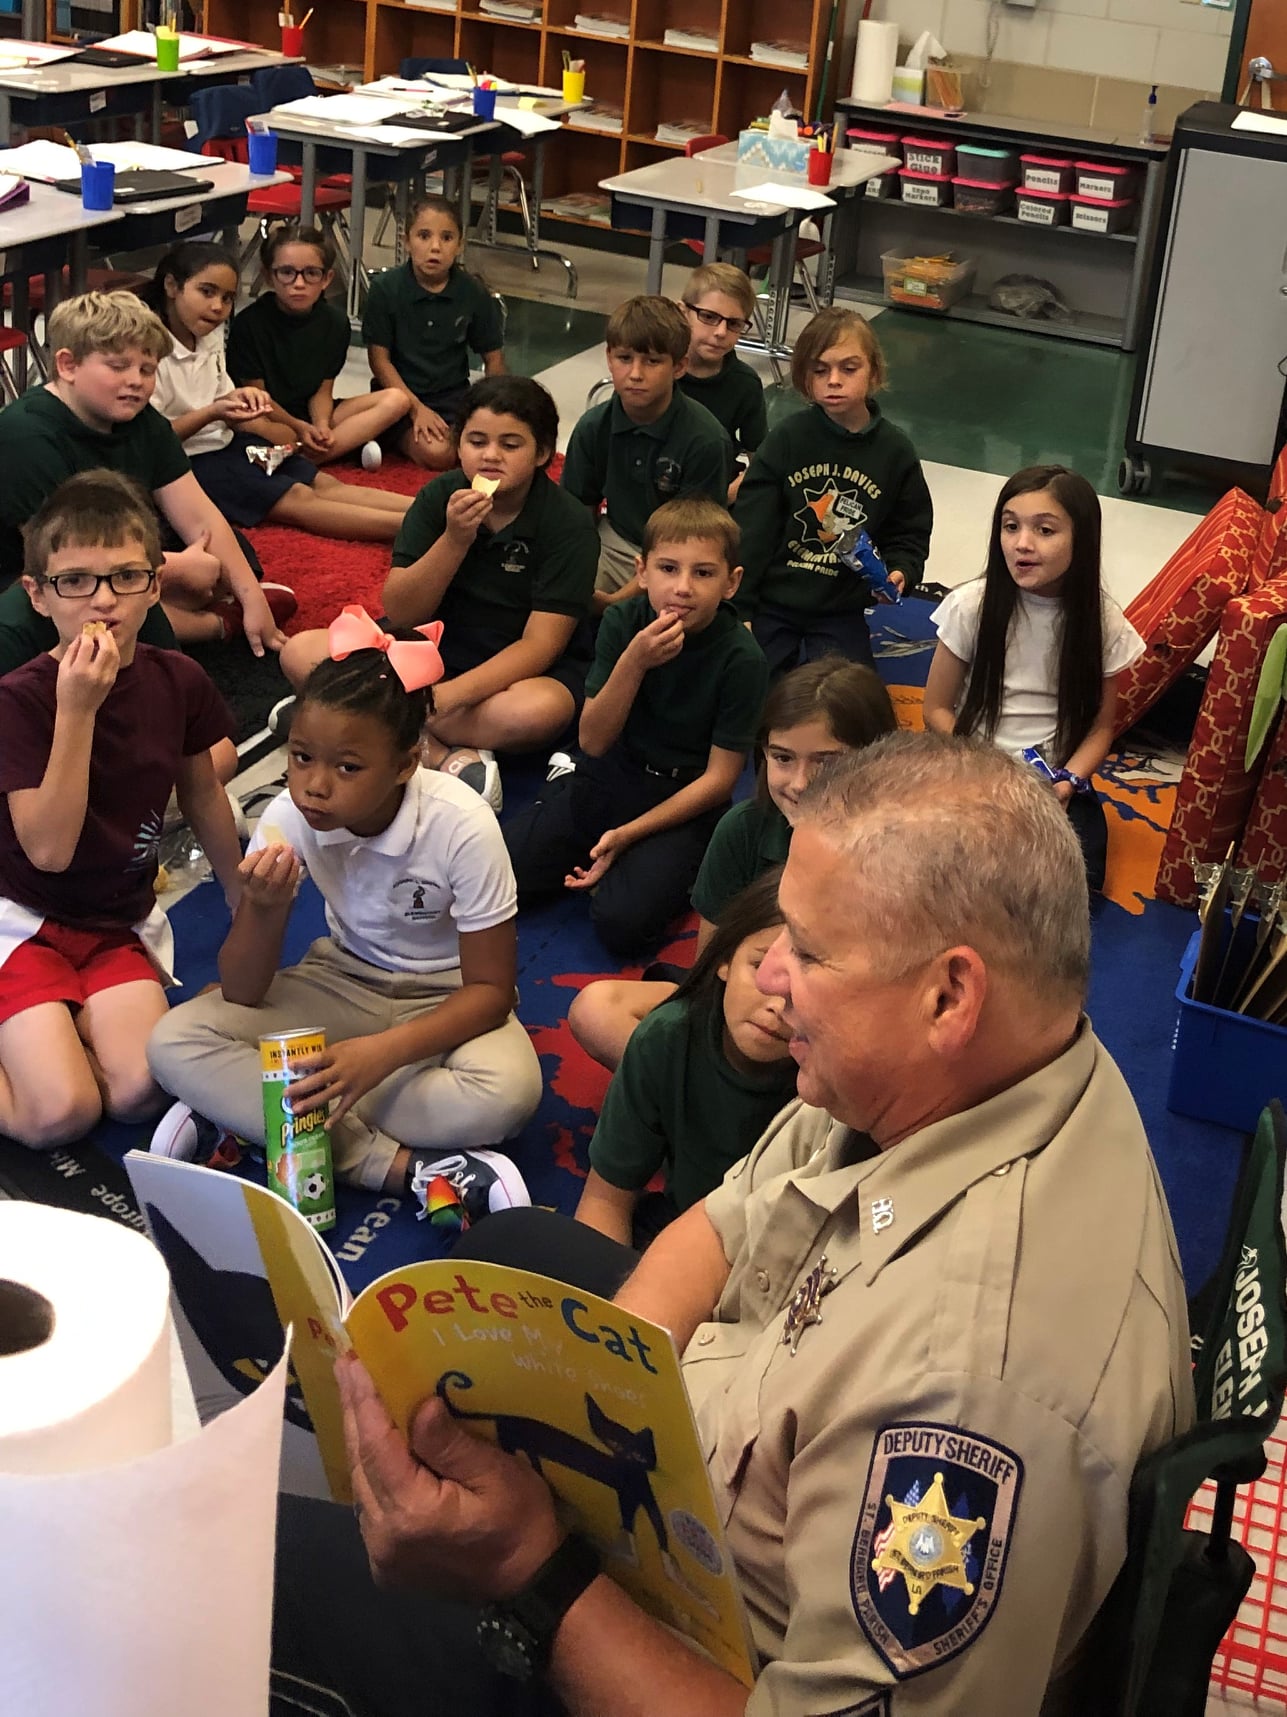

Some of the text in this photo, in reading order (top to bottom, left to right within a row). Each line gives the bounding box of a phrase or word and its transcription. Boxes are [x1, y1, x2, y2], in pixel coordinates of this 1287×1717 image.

[908, 153, 940, 164] Stick
[910, 163, 938, 174] Glue
[1026, 174, 1058, 185] Pencils
[1020, 203, 1052, 214] Colored
[1021, 210, 1049, 221] Pencils
[787, 463, 882, 500] JOSEPH J. DAVIES
[839, 504, 857, 518] PRIDE
[281, 1108, 325, 1148] Pringles
[335, 1198, 401, 1261] cean
[376, 1275, 659, 1375] Pete the Cat
[453, 1322, 513, 1344] Love
[883, 1431, 1014, 1485] DEPUTY SHERIFF
[856, 1531, 873, 1593] BERNARD
[984, 1539, 1003, 1590] OFFICE
[857, 1598, 889, 1645] PARISH
[933, 1597, 989, 1656] SHERIFF'S
